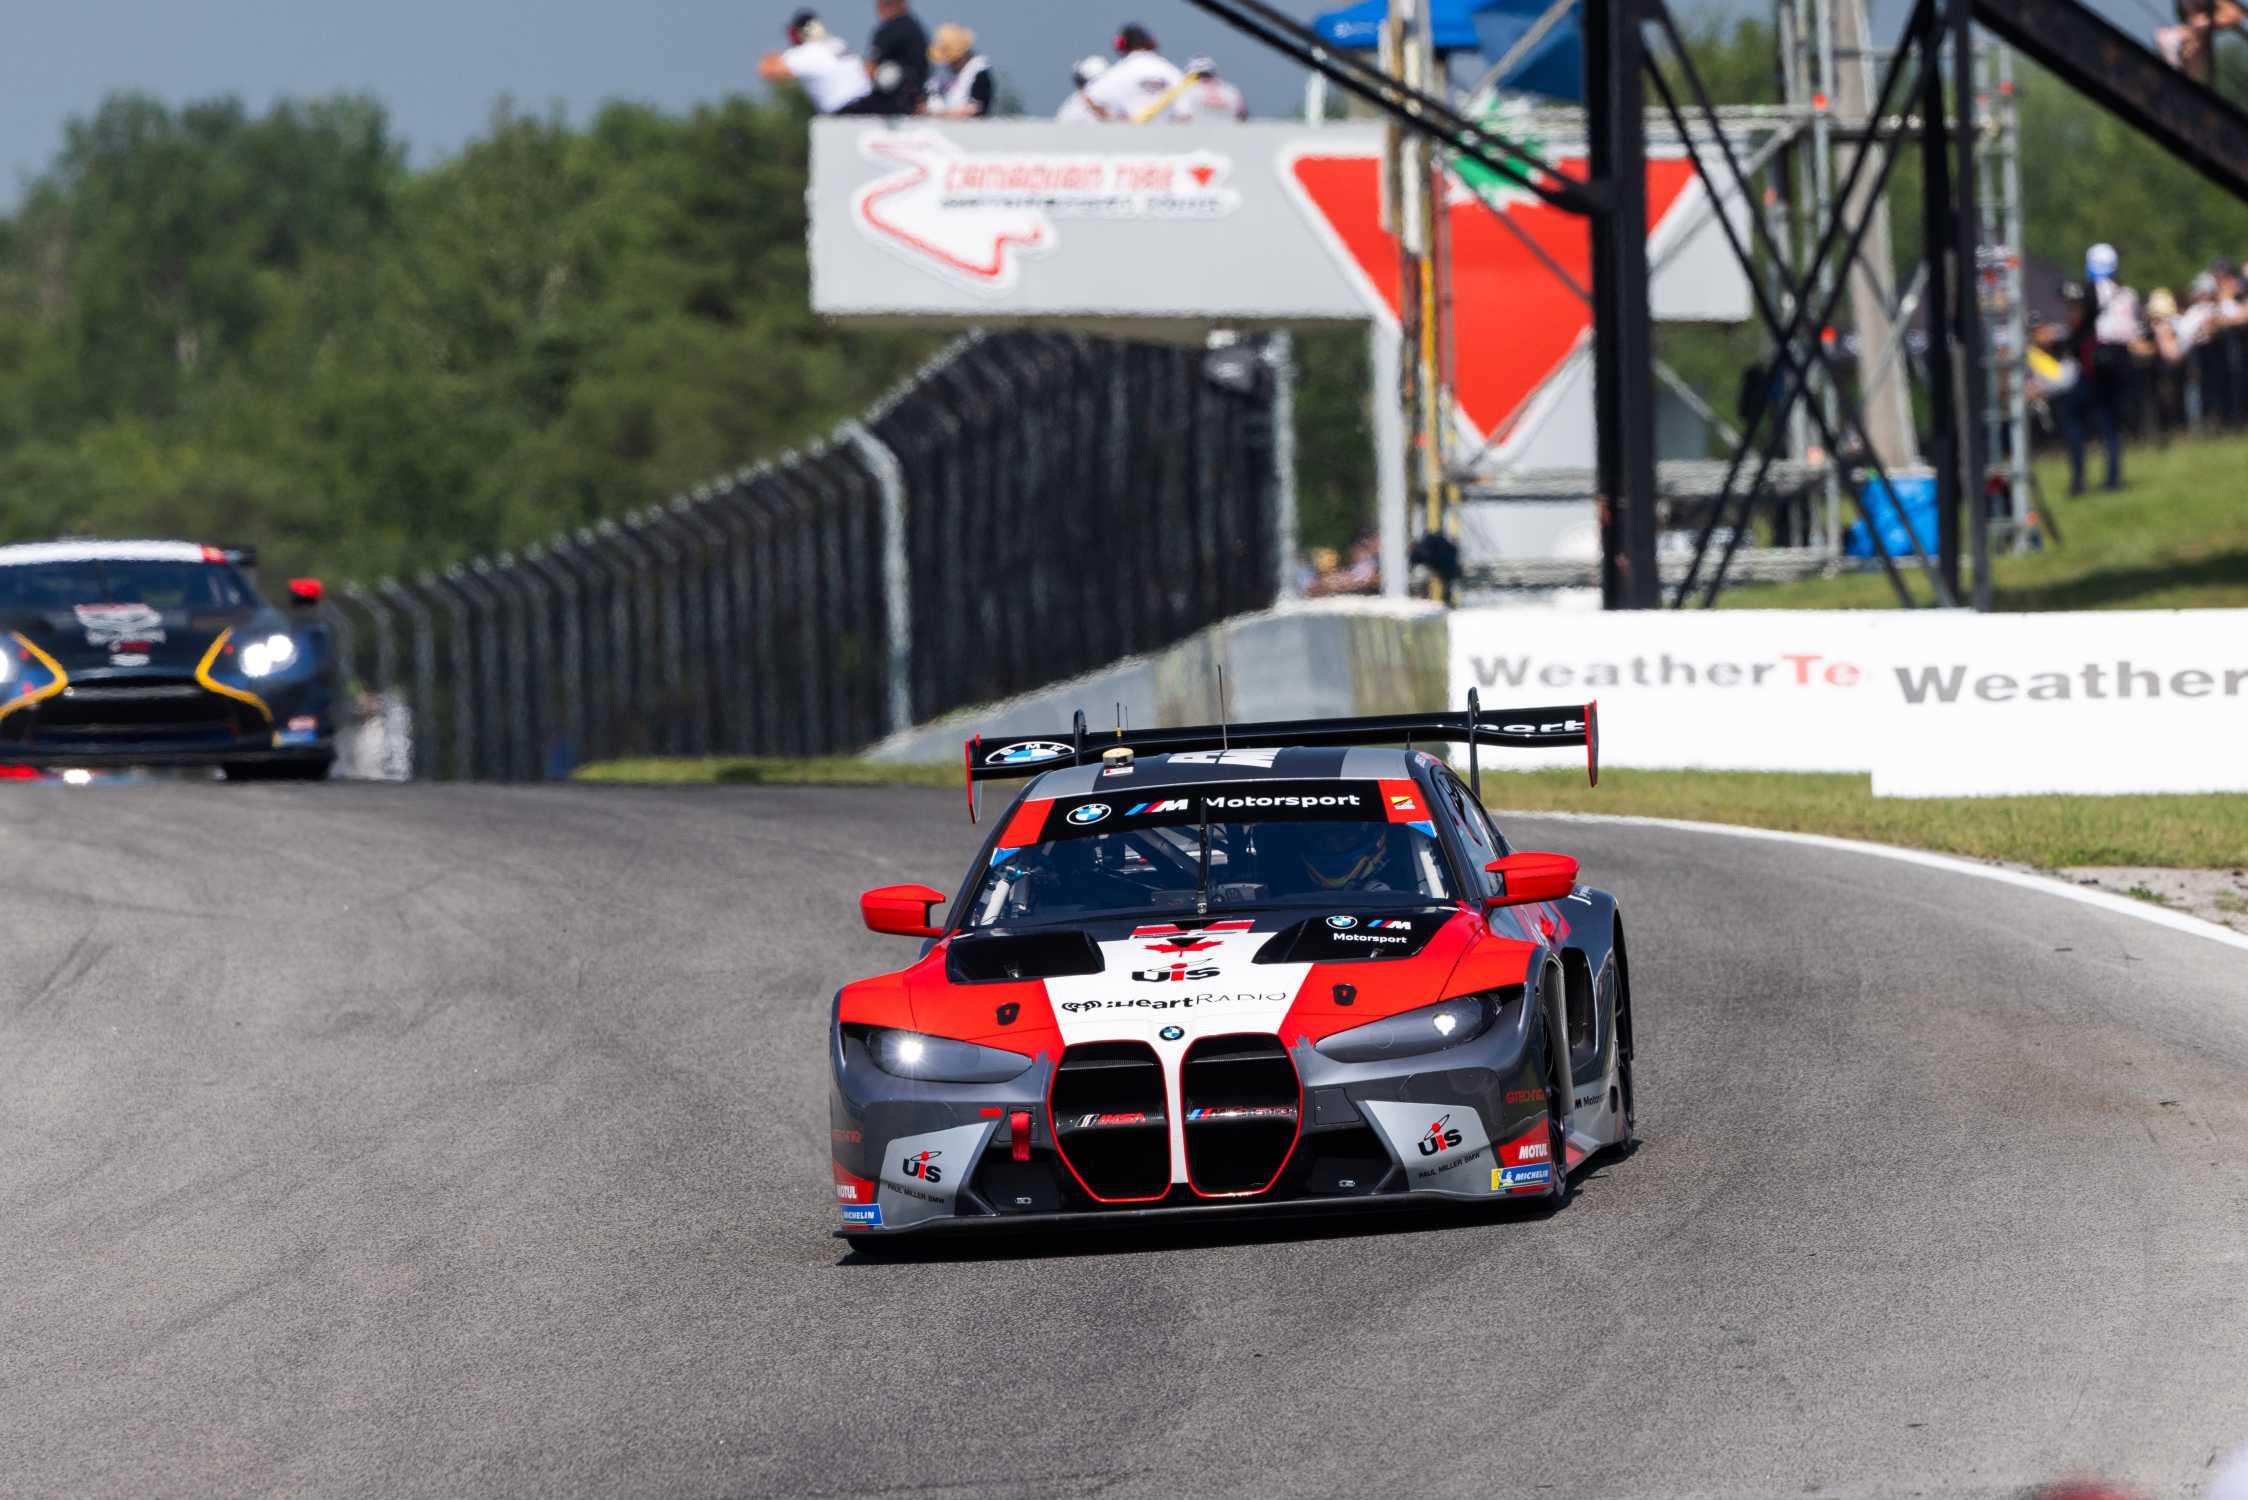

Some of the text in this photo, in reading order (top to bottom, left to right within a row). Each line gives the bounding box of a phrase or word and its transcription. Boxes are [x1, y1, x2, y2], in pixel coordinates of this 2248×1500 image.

[1468, 653, 1862, 689] WeatherTe
[1892, 660, 2248, 704] Weather
[1201, 794, 1361, 809] Motorsport
[1333, 932, 1408, 944] Motorsport
[1518, 1143, 1549, 1160] MOTUL
